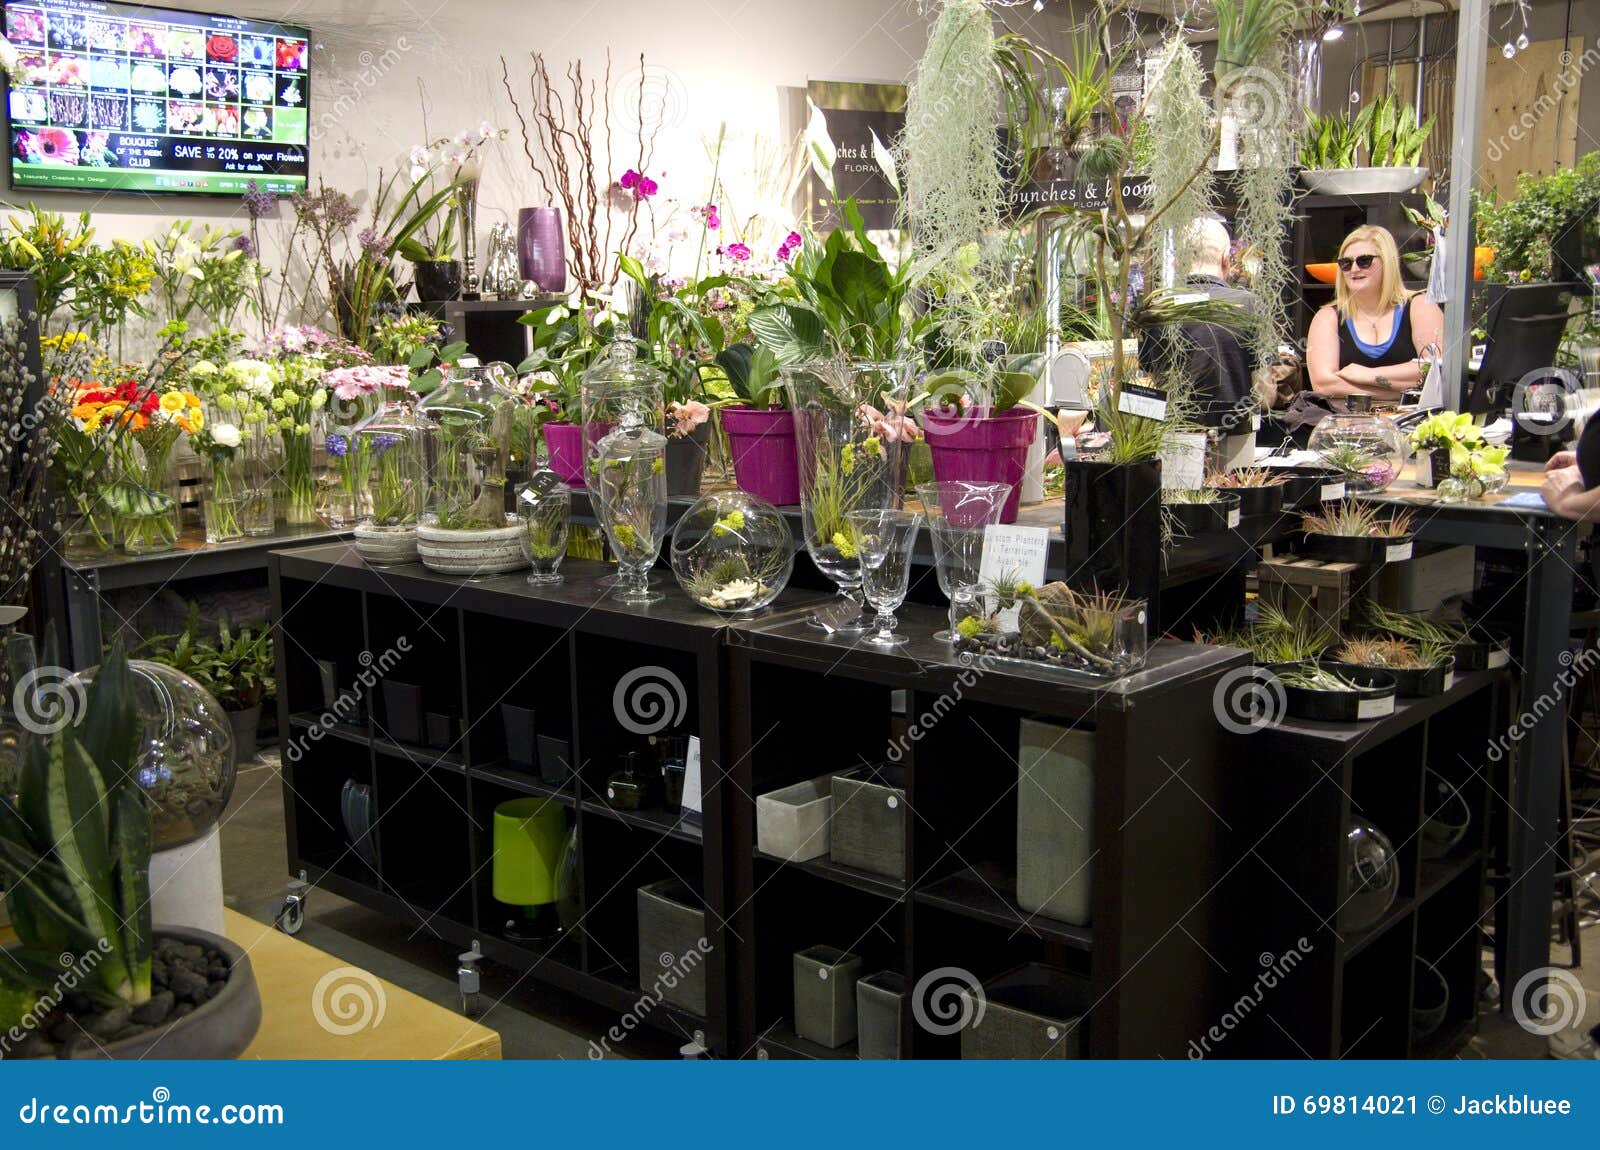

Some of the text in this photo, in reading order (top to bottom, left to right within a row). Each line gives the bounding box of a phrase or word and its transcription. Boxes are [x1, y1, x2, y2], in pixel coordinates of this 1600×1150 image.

[119, 136, 159, 148] BOUQUET
[174, 145, 202, 158] SAVE
[218, 148, 304, 162] 20% on your Flowers
[128, 157, 150, 168] CLUB
[844, 164, 880, 173] FLORAL
[1009, 180, 1157, 203] bunches & boom
[1073, 200, 1112, 209] FLORA
